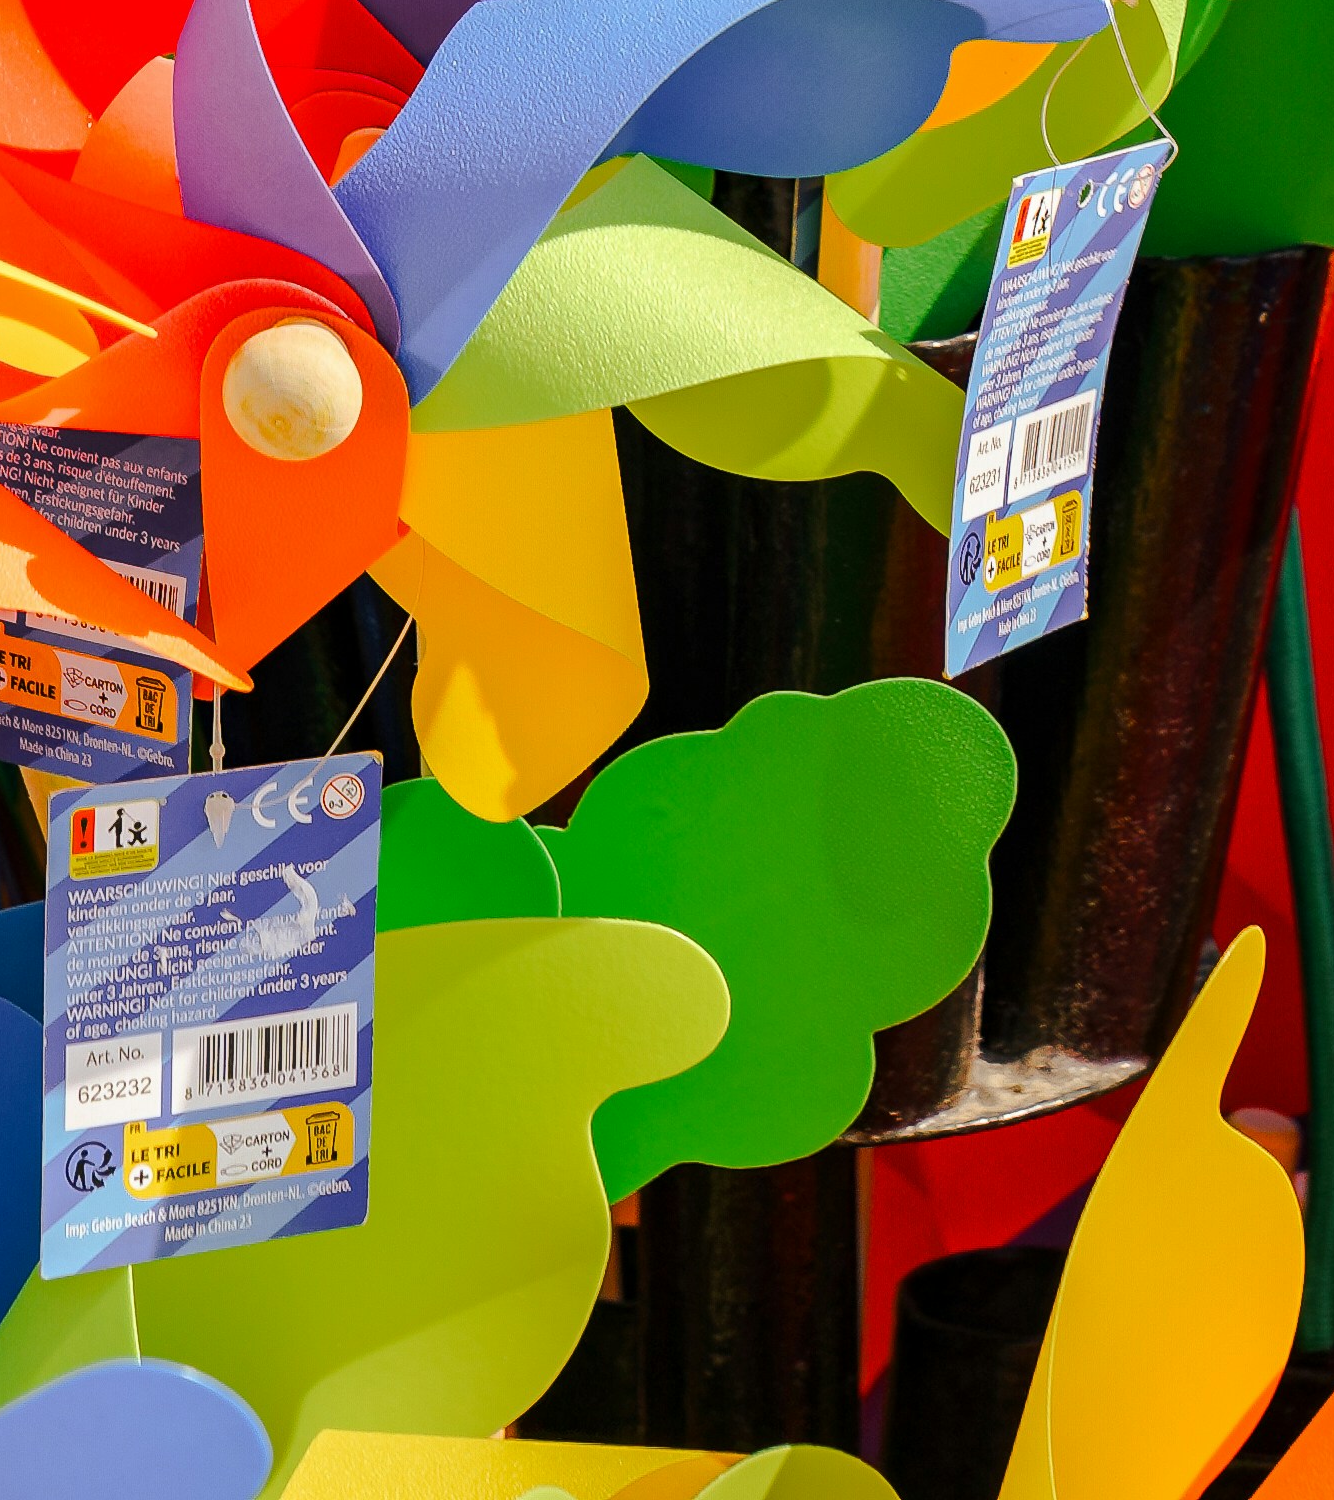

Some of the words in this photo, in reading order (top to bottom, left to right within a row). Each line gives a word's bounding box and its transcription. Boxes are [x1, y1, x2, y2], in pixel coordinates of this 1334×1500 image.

[969, 467, 1001, 495] 623231
[987, 538, 996, 554] LE
[997, 533, 1009, 550] TRI
[996, 552, 1021, 575] FACILE
[10, 652, 31, 671] TRI
[10, 678, 56, 699] FACILE
[85, 677, 123, 694] CARTON
[143, 690, 158, 702] BAC
[89, 704, 116, 719] CORD
[145, 703, 155, 714] DE
[144, 716, 155, 728] TRI
[86, 1050, 114, 1067] Art.
[119, 1046, 144, 1062] No.
[78, 1077, 152, 1104] 623232
[205, 1077, 268, 1096] 713836
[277, 1067, 340, 1086] 041568
[245, 1130, 290, 1147] CARTON
[314, 1124, 331, 1136] BAC
[317, 1137, 327, 1148] DE
[132, 1150, 150, 1164] LE
[154, 1145, 180, 1159] TRI
[316, 1148, 330, 1162] TRI
[157, 1161, 210, 1181] FACILE
[251, 1158, 282, 1172] CORD
